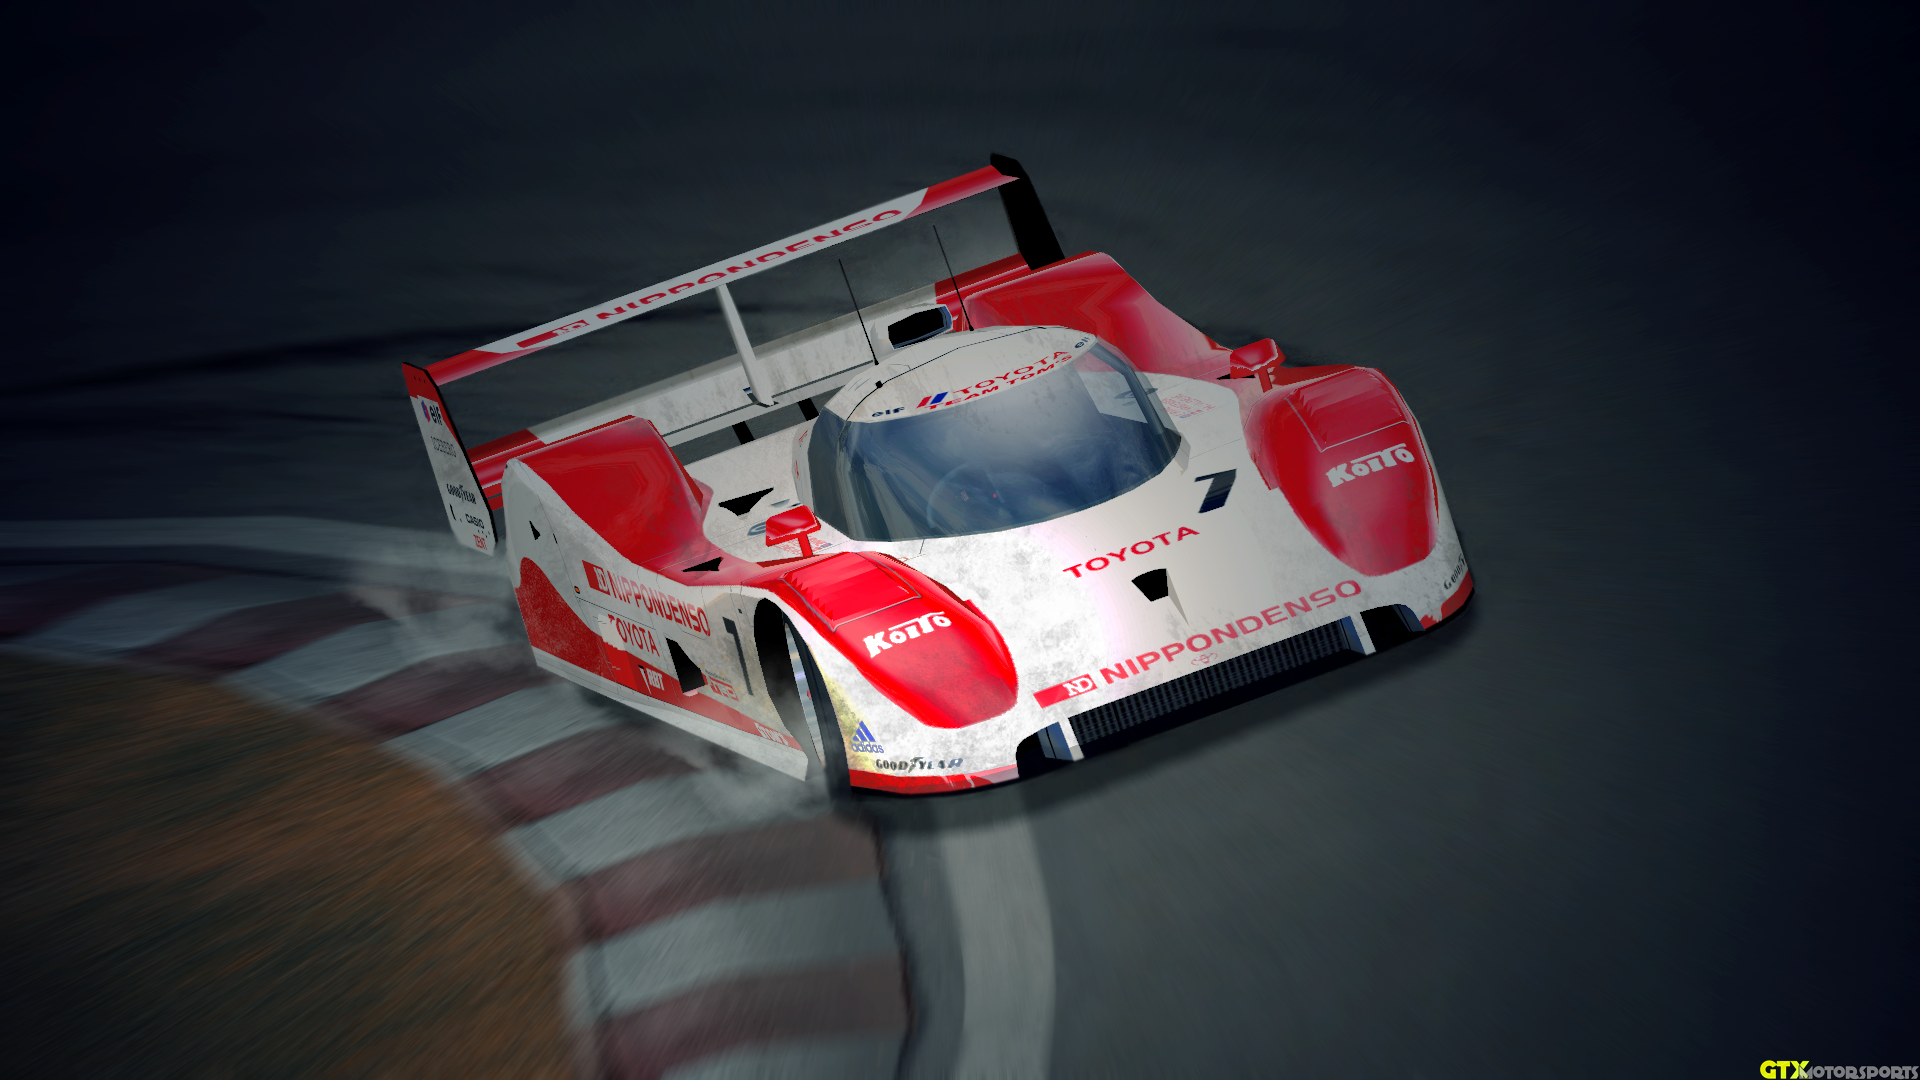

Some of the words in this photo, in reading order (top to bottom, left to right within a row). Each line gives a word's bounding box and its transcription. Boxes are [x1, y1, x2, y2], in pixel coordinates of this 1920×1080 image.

[953, 351, 1069, 394] TOYOTA
[429, 405, 443, 426] elf
[924, 385, 998, 410] TEAM
[1194, 468, 1237, 514] 7
[1062, 526, 1200, 578] TOYOTA
[607, 570, 711, 637] NIPPONDENSO
[1062, 677, 1093, 697] ND
[1099, 579, 1363, 684] NIPPONDENSO
[851, 742, 884, 753] adidas
[876, 757, 963, 773] GOODYEAR
